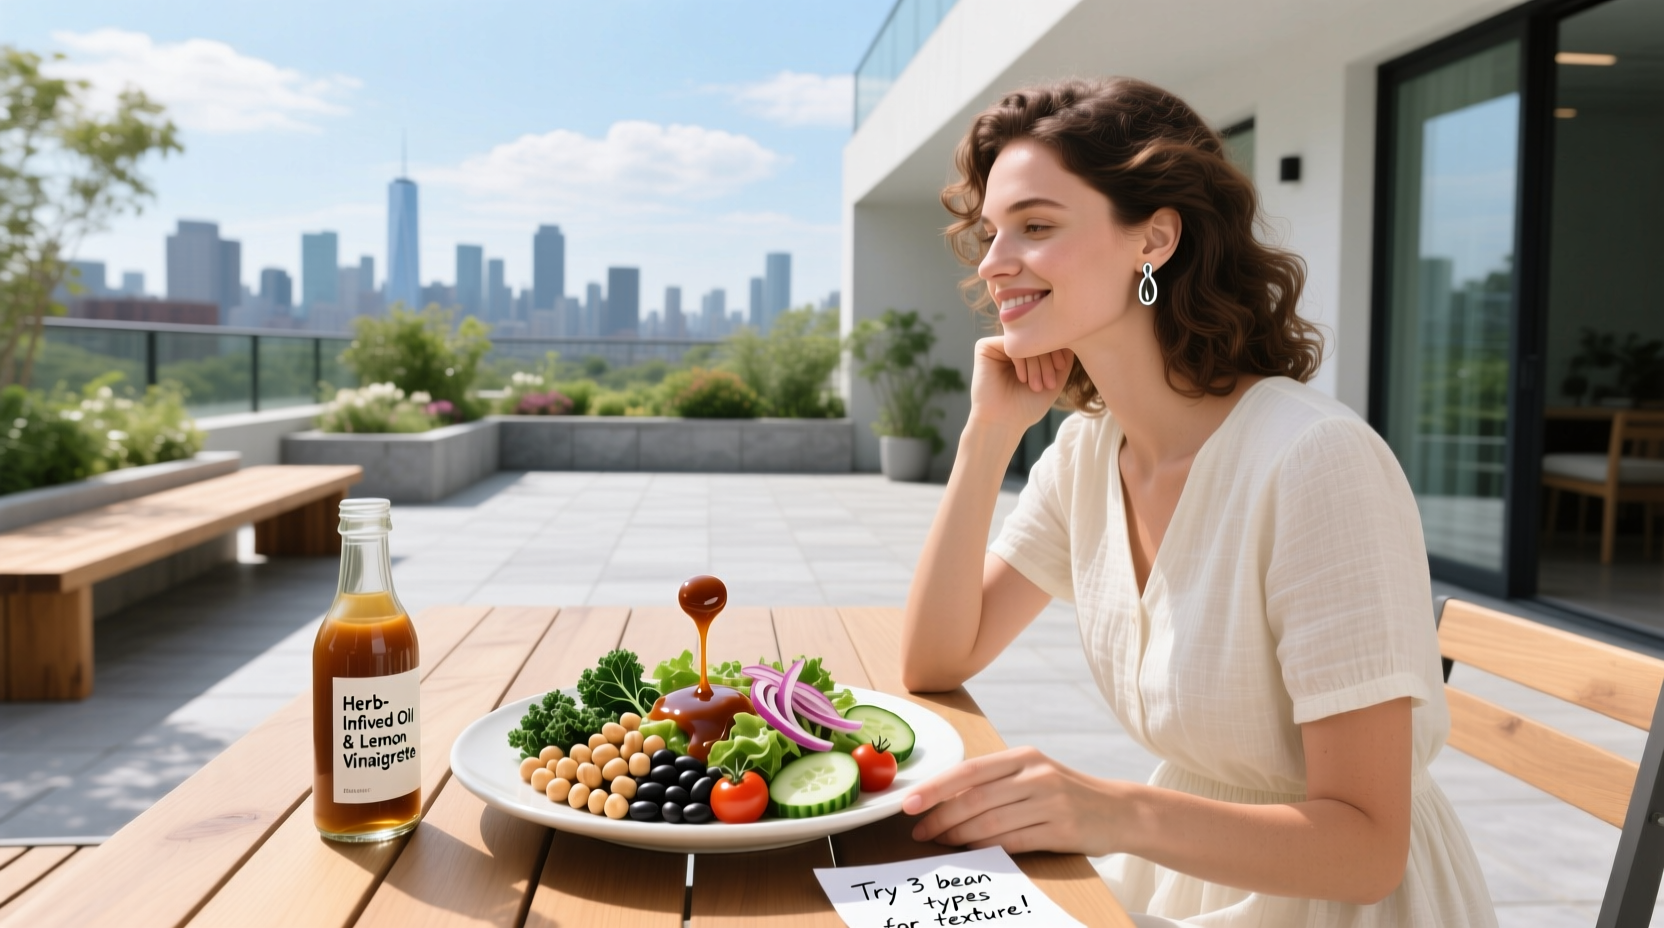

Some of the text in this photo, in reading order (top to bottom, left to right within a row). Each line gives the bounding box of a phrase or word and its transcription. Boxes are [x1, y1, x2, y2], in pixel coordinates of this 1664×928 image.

[343, 694, 389, 711] Herb-
[343, 733, 407, 749] & Lemon
[851, 873, 992, 906] Try 3 bean
[883, 894, 1032, 928] for texture!
[923, 891, 990, 914] types
